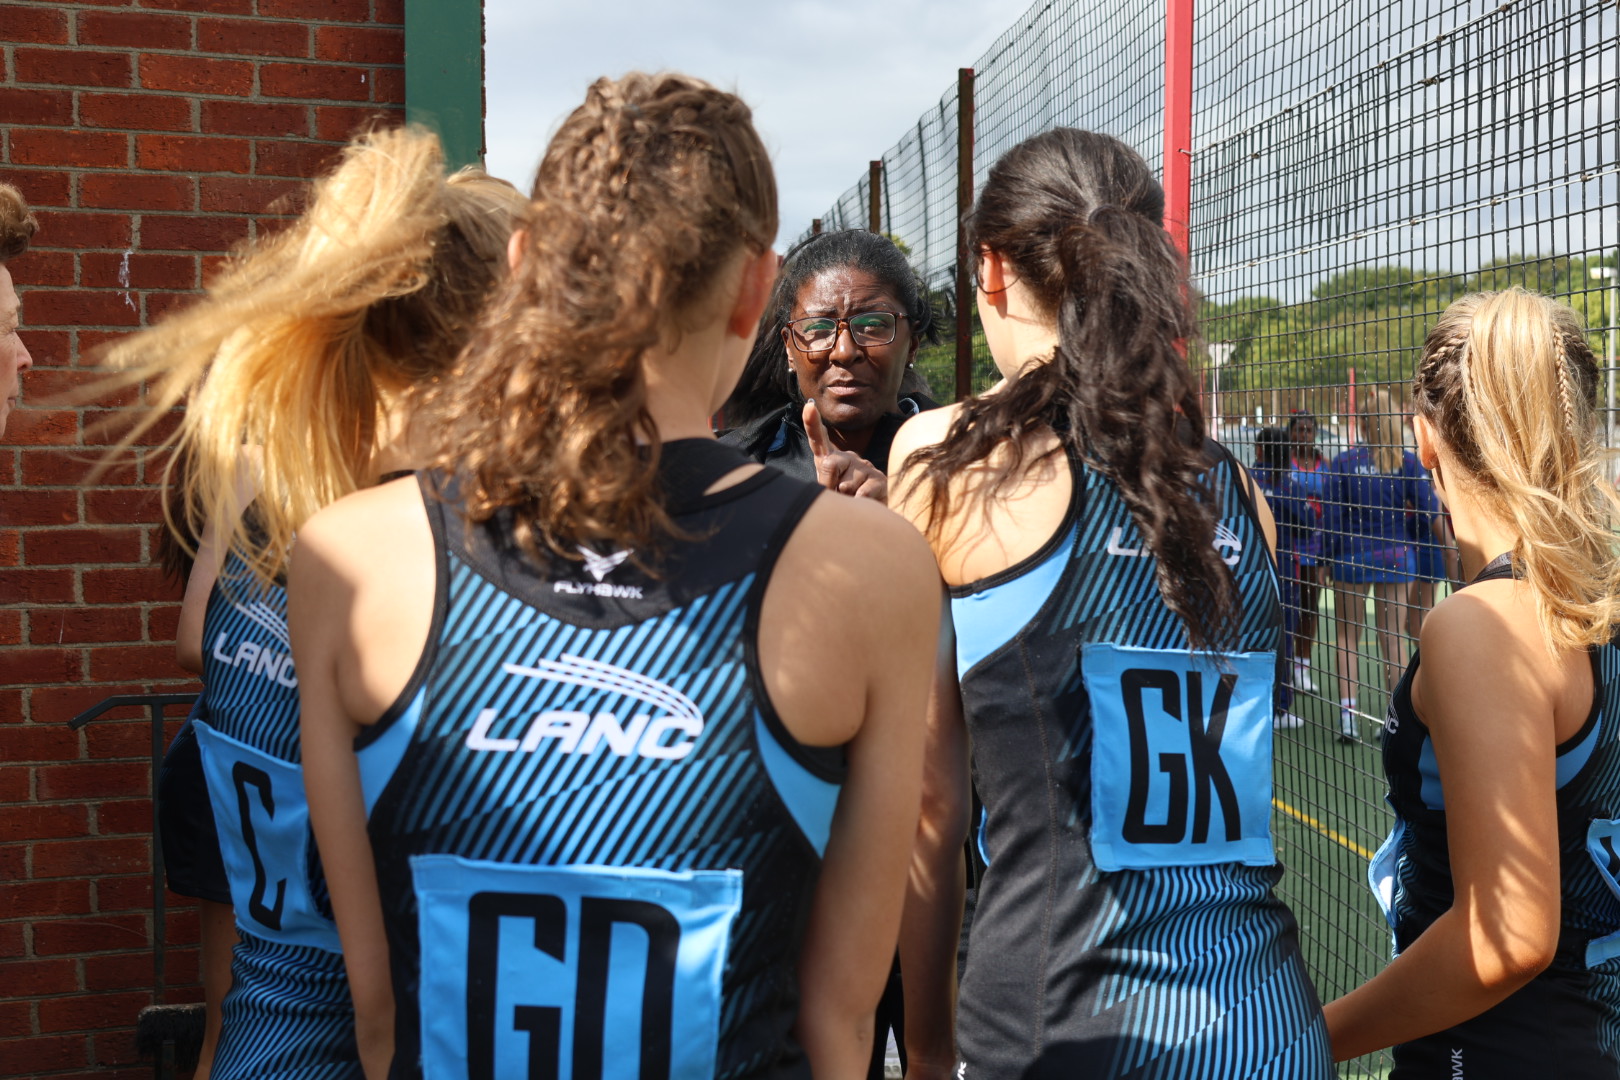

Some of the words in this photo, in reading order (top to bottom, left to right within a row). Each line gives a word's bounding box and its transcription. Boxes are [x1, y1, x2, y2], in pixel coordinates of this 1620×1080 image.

[1107, 527, 1242, 566] LC
[465, 708, 704, 760] LANC
[1120, 668, 1242, 844] GK
[232, 761, 287, 931] C
[466, 890, 681, 1080] GD
